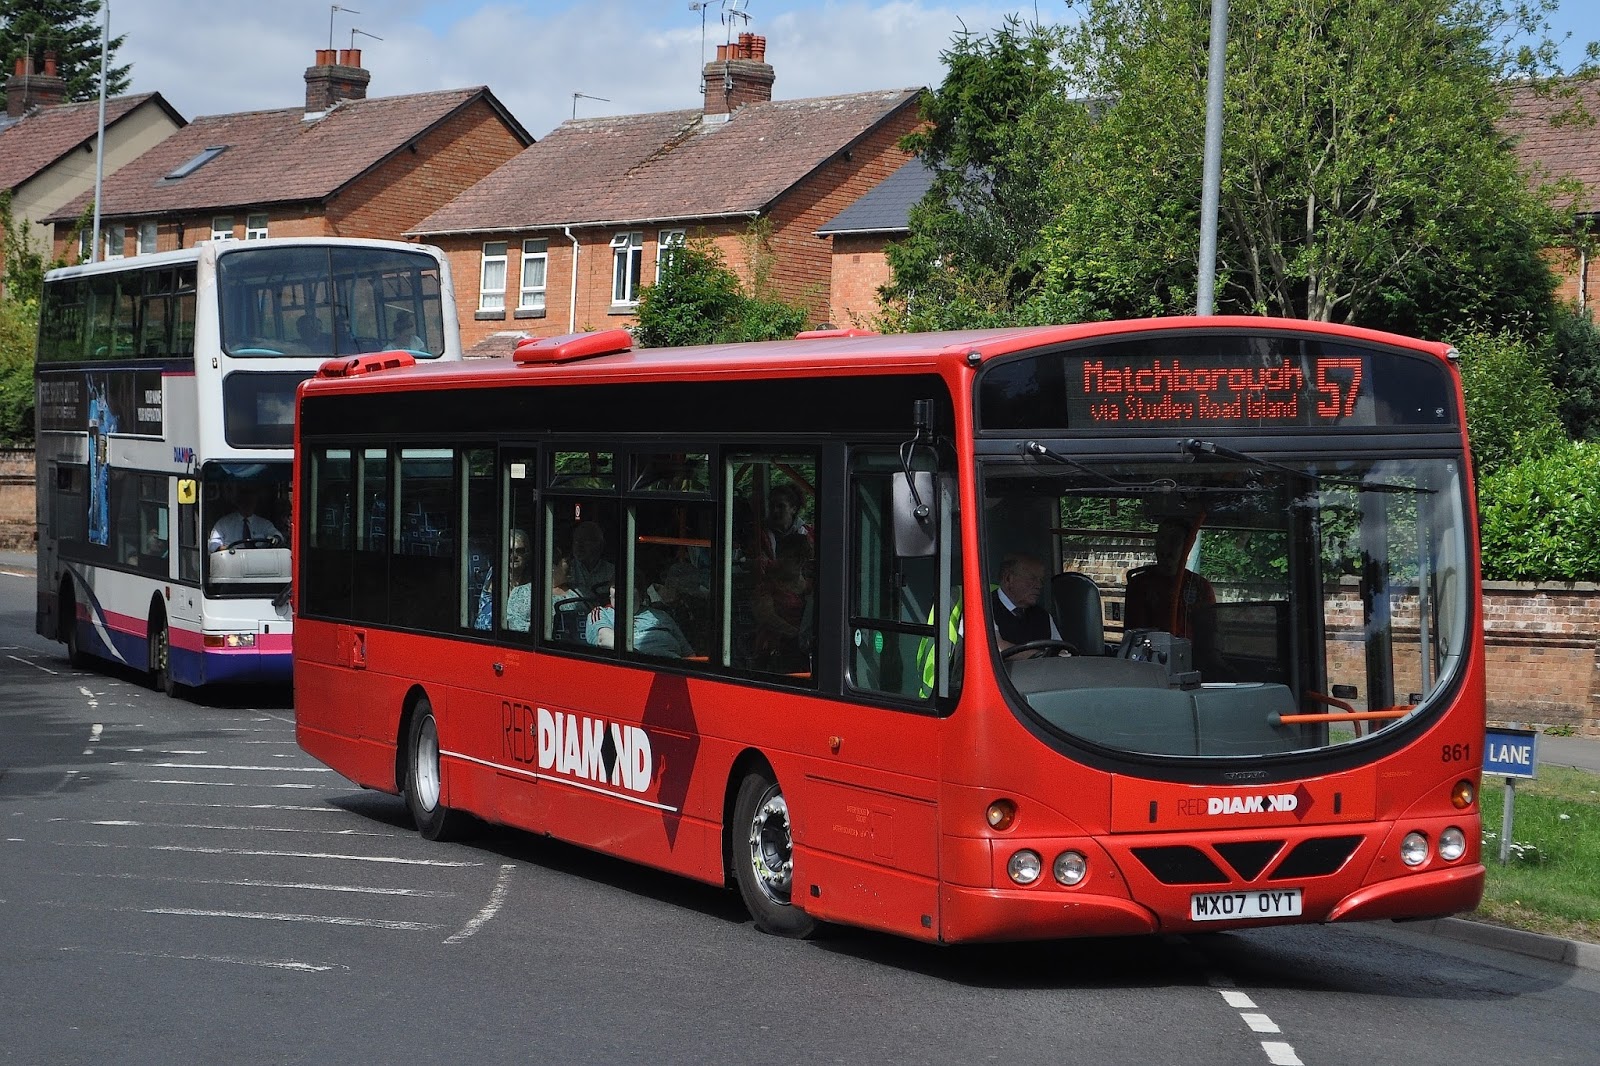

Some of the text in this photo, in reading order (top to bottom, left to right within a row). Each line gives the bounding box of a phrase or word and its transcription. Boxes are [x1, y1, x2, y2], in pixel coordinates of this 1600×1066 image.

[1083, 358, 1303, 393] Matchborough
[1316, 358, 1362, 418] 57
[1090, 393, 1297, 421] via Studley Road Island
[502, 700, 536, 764] RED
[1442, 743, 1470, 763] 861
[1489, 743, 1531, 765] LANE
[1177, 798, 1208, 816] RED
[1195, 892, 1296, 916] MX07 OYT
